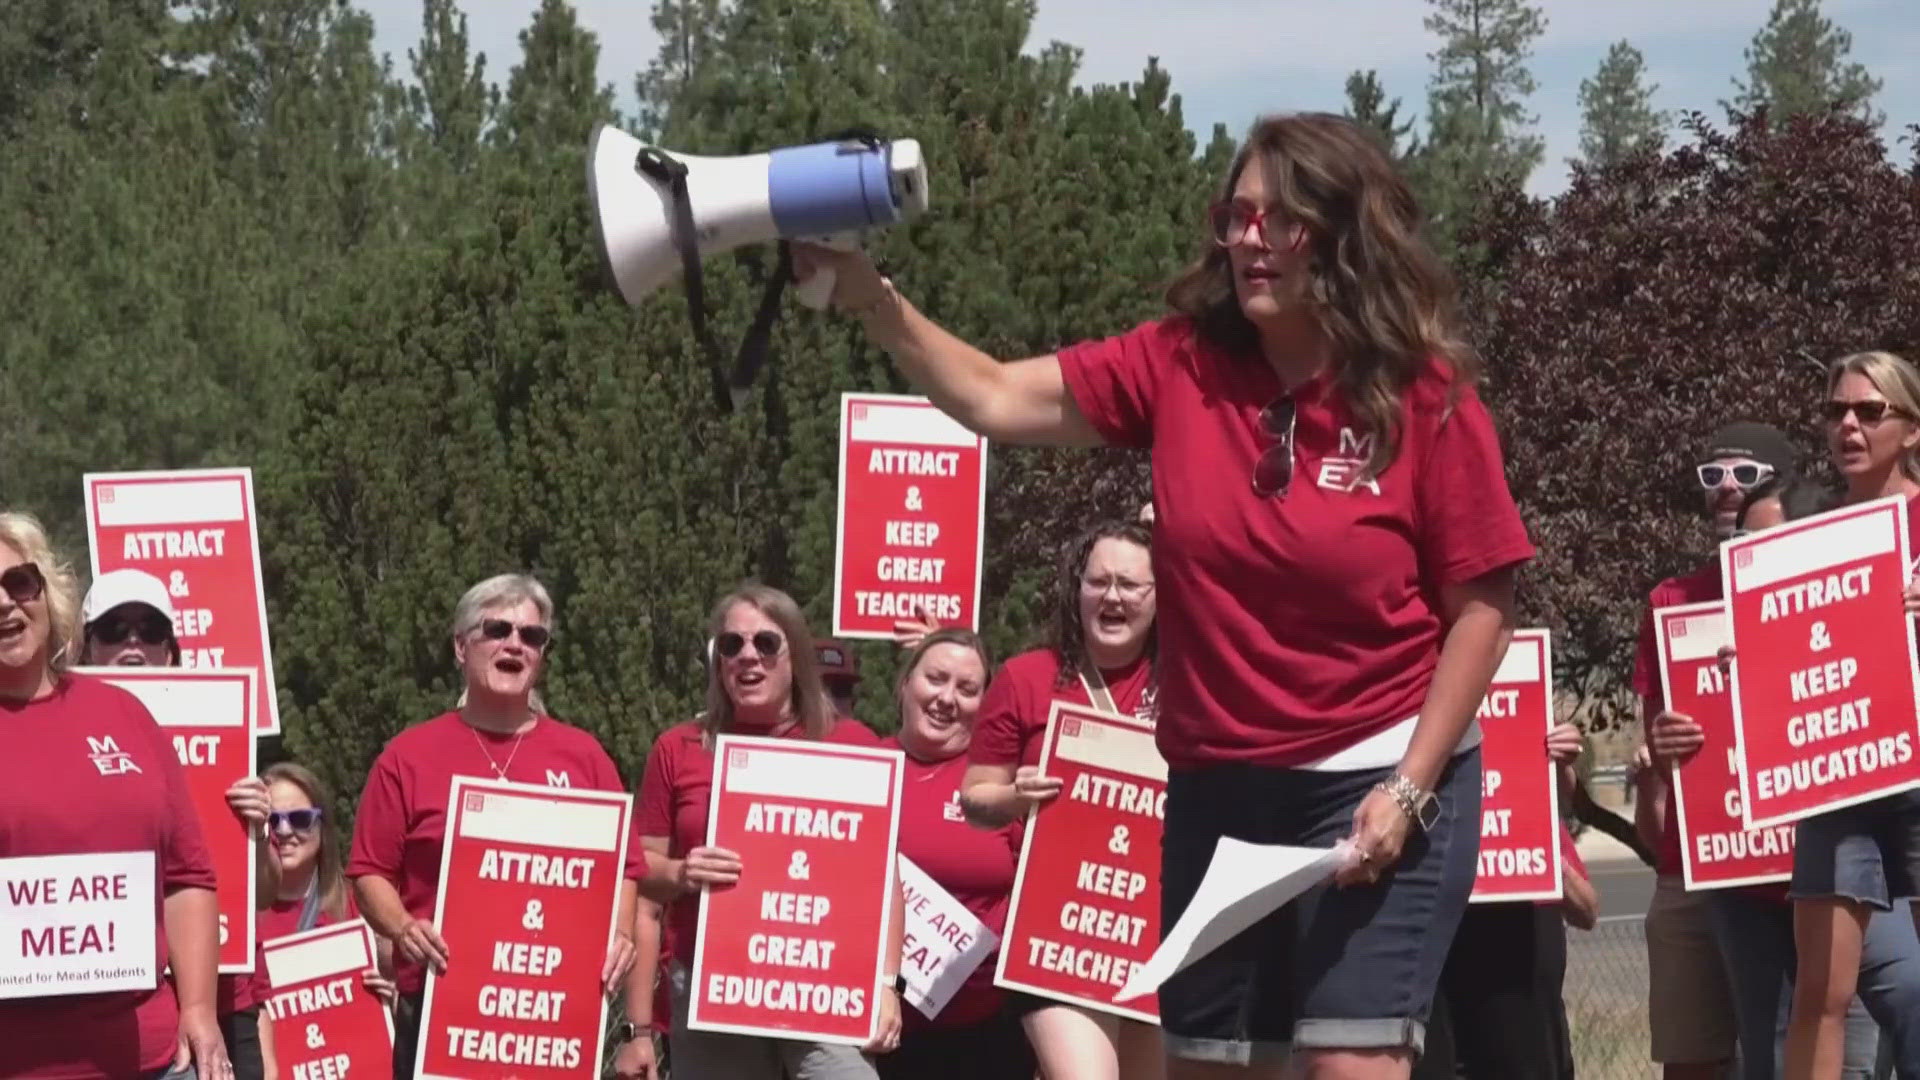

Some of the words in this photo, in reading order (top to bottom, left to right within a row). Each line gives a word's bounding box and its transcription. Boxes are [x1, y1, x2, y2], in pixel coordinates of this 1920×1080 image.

[868, 447, 960, 477] ATTRACT
[904, 485, 923, 512] &
[123, 528, 226, 561] ATTRACT
[885, 520, 940, 547] KEEP
[168, 569, 190, 598] &
[877, 555, 946, 583] GREAT
[855, 591, 962, 621] TEACHERS
[1760, 564, 1873, 624] ATTRACT
[171, 607, 214, 638] EEP
[1809, 620, 1832, 652] &
[1789, 657, 1858, 702] KEEP
[1786, 697, 1872, 748] GREAT
[1756, 731, 1913, 800] EDUCATORS
[1070, 773, 1168, 820] ATTRAC
[744, 804, 864, 842] ATTRACT
[1108, 824, 1130, 855] &
[478, 849, 596, 889] ATTRACT
[787, 849, 811, 881] &
[1076, 860, 1147, 901] KEEP
[7, 878, 58, 906] WE
[68, 873, 128, 903] ARE
[521, 899, 545, 931] &
[760, 890, 831, 925] KEEP
[1060, 901, 1148, 947] GREAT
[21, 920, 115, 958] MEA!
[927, 912, 973, 954] ARE
[492, 941, 563, 977] KEEP
[747, 933, 836, 971] GREAT
[902, 933, 942, 977] EA!
[36, 972, 53, 983] for
[56, 969, 90, 982] Mead
[93, 966, 147, 979] Students
[478, 985, 567, 1022] GREAT
[707, 973, 865, 1018] EDUCATORS
[305, 1023, 326, 1050] &
[446, 1026, 582, 1069] TEACHERS
[292, 1053, 351, 1080] KEEP
